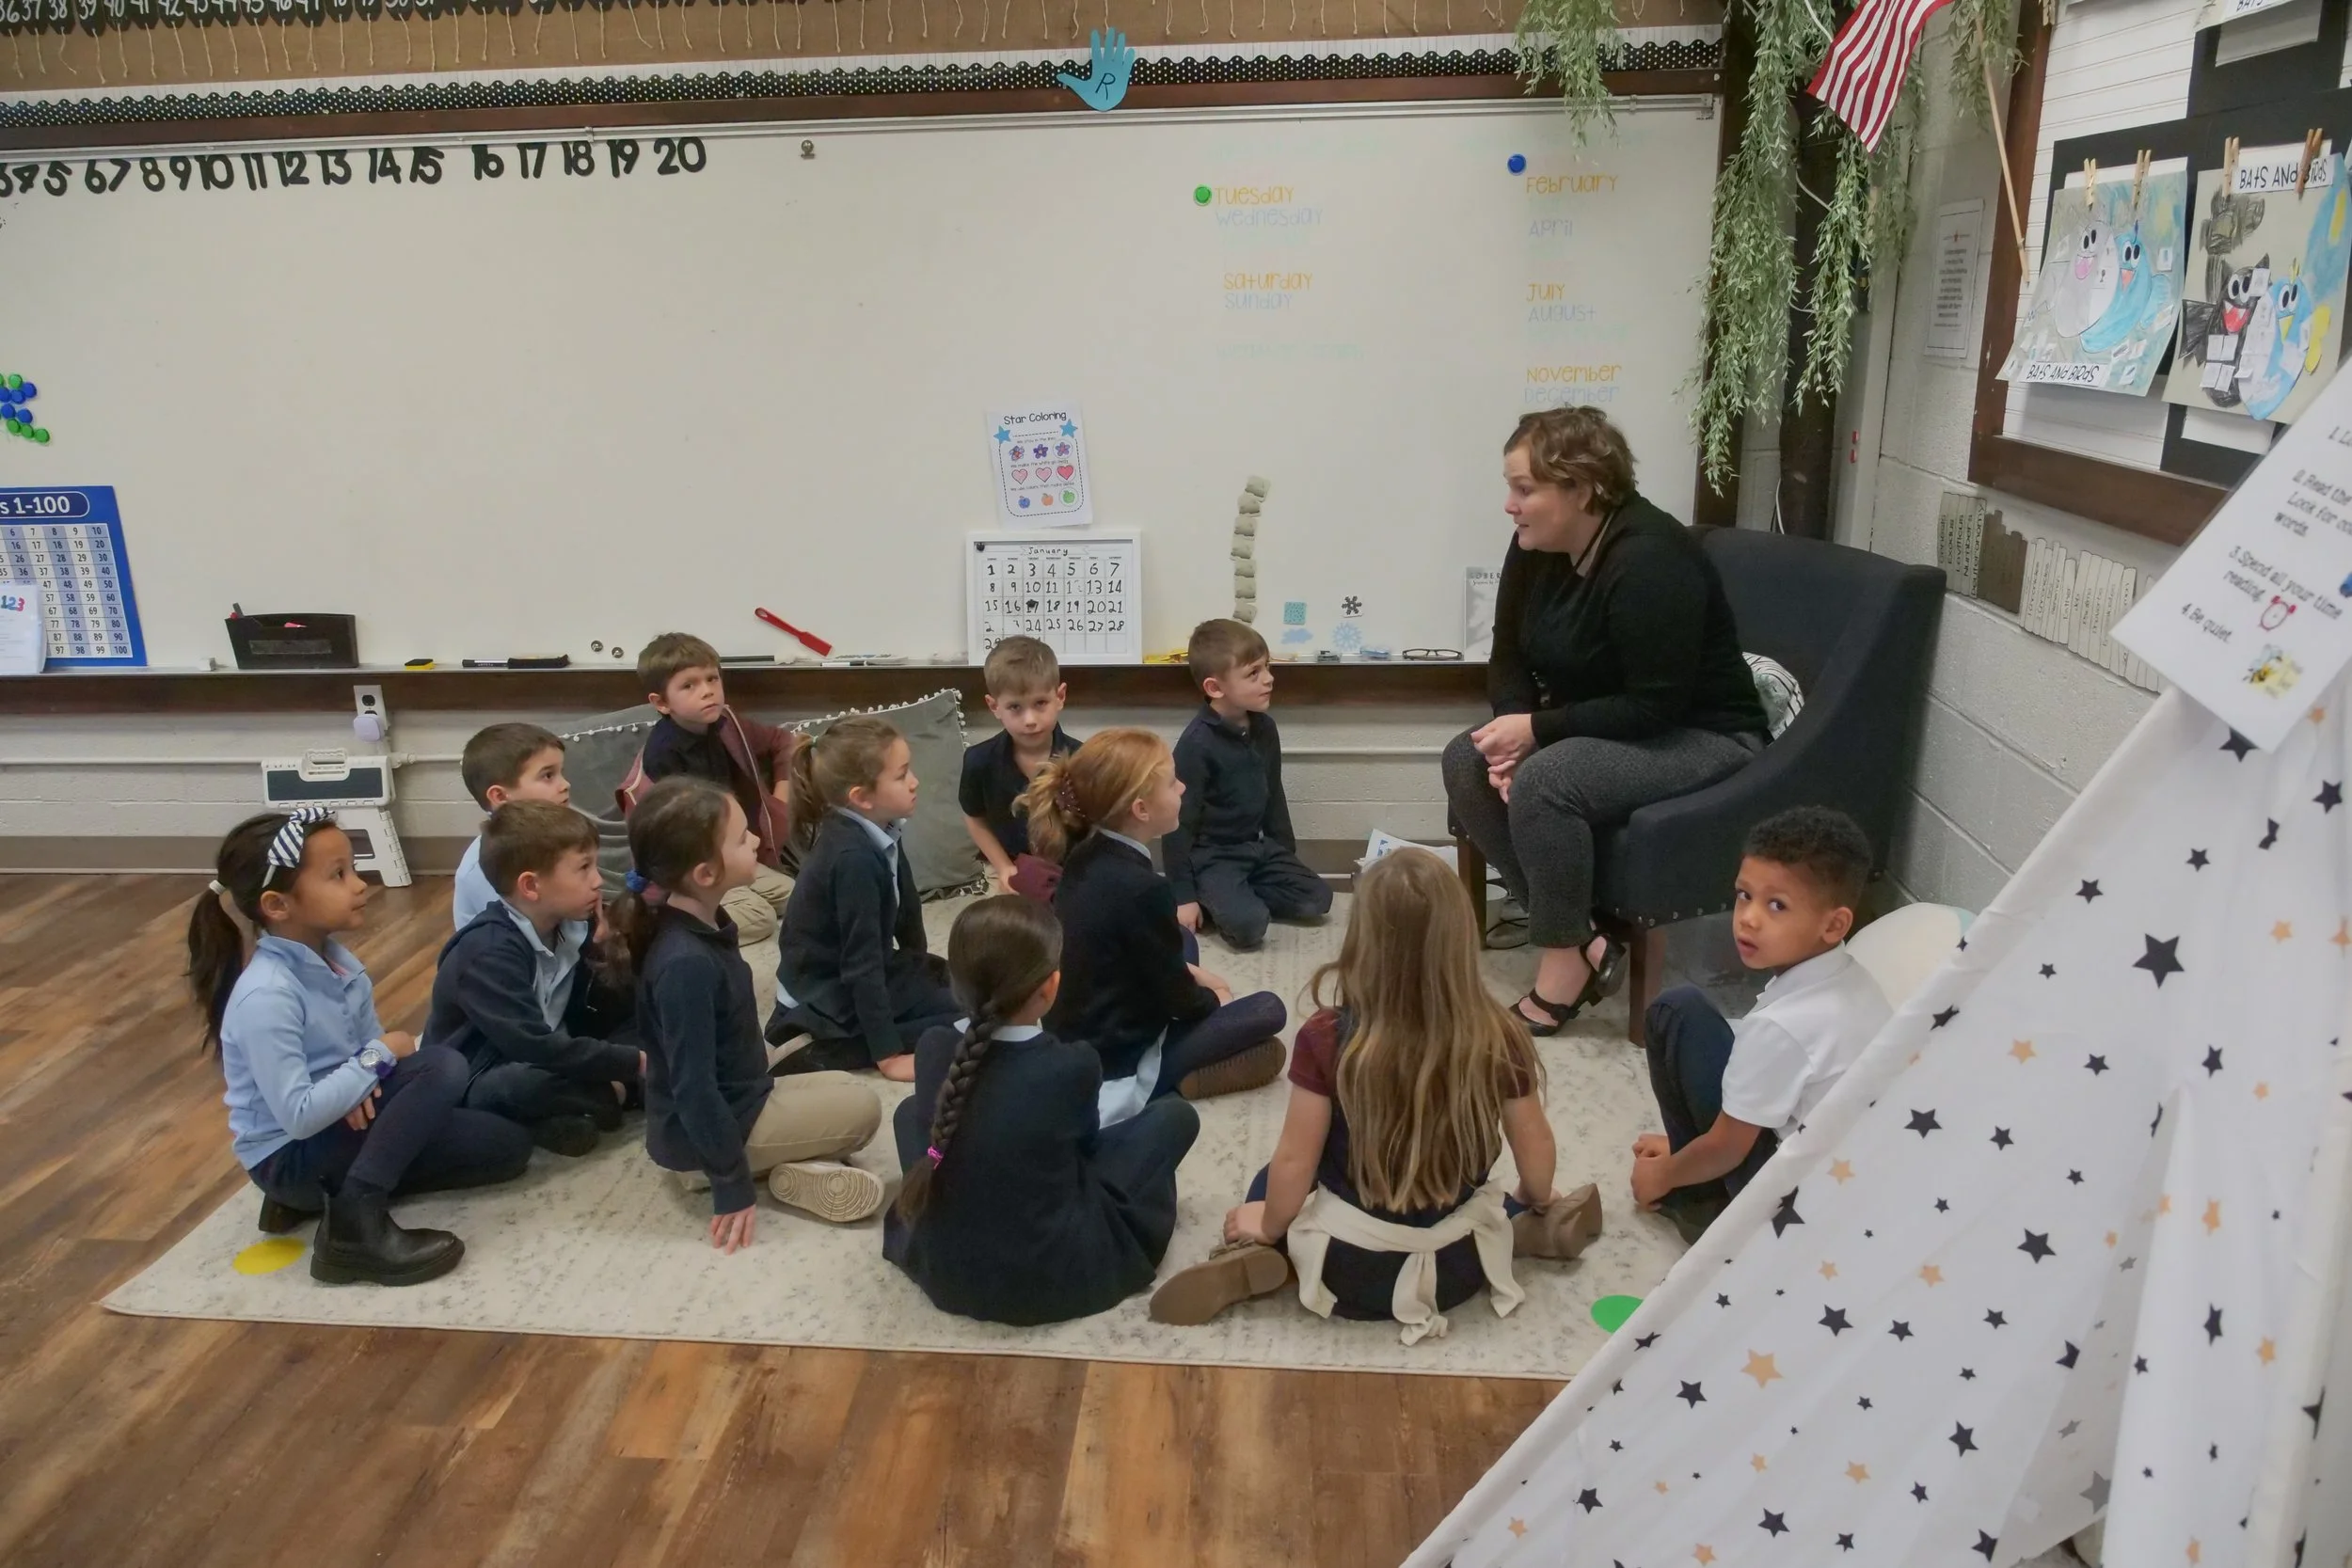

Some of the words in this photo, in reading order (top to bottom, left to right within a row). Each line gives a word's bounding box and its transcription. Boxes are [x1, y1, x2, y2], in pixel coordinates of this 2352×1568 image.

[22, 0, 40, 21] 37
[49, 0, 68, 21] 38
[79, 0, 96, 20] 39
[103, 0, 125, 17] 40
[1095, 72, 1116, 101] R
[43, 161, 72, 197] 5
[85, 159, 107, 194] 6
[108, 158, 132, 192] 7
[139, 157, 166, 192] 8
[168, 156, 192, 191] 9
[194, 154, 234, 191] 10
[240, 152, 268, 191] 11
[272, 150, 310, 187] 12
[315, 149, 352, 185] 13
[368, 148, 402, 184] 14
[408, 146, 445, 184] 15
[471, 144, 504, 181] 16
[516, 142, 548, 179] 17
[562, 140, 595, 177] 18
[607, 139, 640, 178] 19
[654, 136, 707, 175] 20
[1004, 415, 1026, 425] Star
[1029, 412, 1067, 422] Coloring
[13, 496, 70, 514] 1-100
[10, 528, 15, 537] 6
[30, 528, 35, 537] 7
[52, 528, 57, 536] 8
[73, 528, 78, 536] 9
[92, 527, 102, 535] 10
[12, 542, 21, 550] 16
[32, 542, 40, 550] 17
[53, 541, 62, 549] 18
[75, 541, 83, 549] 19
[95, 540, 104, 549] 20
[1028, 546, 1068, 556] January
[16, 554, 24, 563] 26
[36, 554, 44, 563] 27
[56, 554, 66, 562] 28
[78, 554, 87, 562] 29
[99, 554, 108, 562] 30
[19, 568, 28, 577] 36
[40, 568, 48, 576] 37
[60, 567, 69, 576] 38
[81, 567, 90, 576] 39
[102, 567, 111, 575] 40
[987, 565, 995, 575] 1
[1008, 564, 1015, 574] 2
[1029, 563, 1036, 577] 3
[1047, 563, 1056, 577] 4
[1067, 562, 1075, 576] 5
[1089, 563, 1098, 575] 6
[1110, 562, 1120, 577] 7
[43, 581, 51, 589] 47
[64, 581, 72, 589] 48
[84, 580, 93, 589] 49
[104, 580, 112, 588] 50
[990, 583, 995, 592] 8
[1011, 582, 1017, 592] 9
[1025, 581, 1041, 593] 10
[1046, 581, 1058, 593] 11
[1087, 579, 1102, 594] 13
[1108, 580, 1122, 593] 14
[46, 594, 54, 602] 57
[66, 594, 75, 602] 58
[86, 594, 95, 602] 59
[106, 594, 115, 602] 60
[48, 607, 57, 616] 67
[69, 607, 77, 616] 68
[89, 607, 97, 615] 69
[109, 607, 118, 615] 70
[985, 600, 998, 612] 15
[1005, 600, 1021, 614] 16
[1046, 599, 1061, 612] 18
[1067, 600, 1080, 614] 19
[1087, 600, 1106, 614] 20
[1108, 600, 1123, 614] 21
[51, 620, 59, 629] 77
[71, 620, 80, 629] 78
[92, 620, 100, 628] 79
[112, 620, 120, 628] 80
[1025, 619, 1042, 632] 24
[1046, 618, 1061, 629] 25
[1067, 618, 1083, 632] 26
[1088, 621, 1104, 632] 27
[1108, 620, 1124, 632] 28
[53, 634, 62, 642] 87
[74, 634, 82, 642] 88
[94, 633, 103, 641] 89
[114, 633, 123, 641] 90
[56, 646, 64, 655] 97
[76, 646, 85, 655] 98
[96, 646, 105, 655] 99
[114, 646, 127, 654] 100
